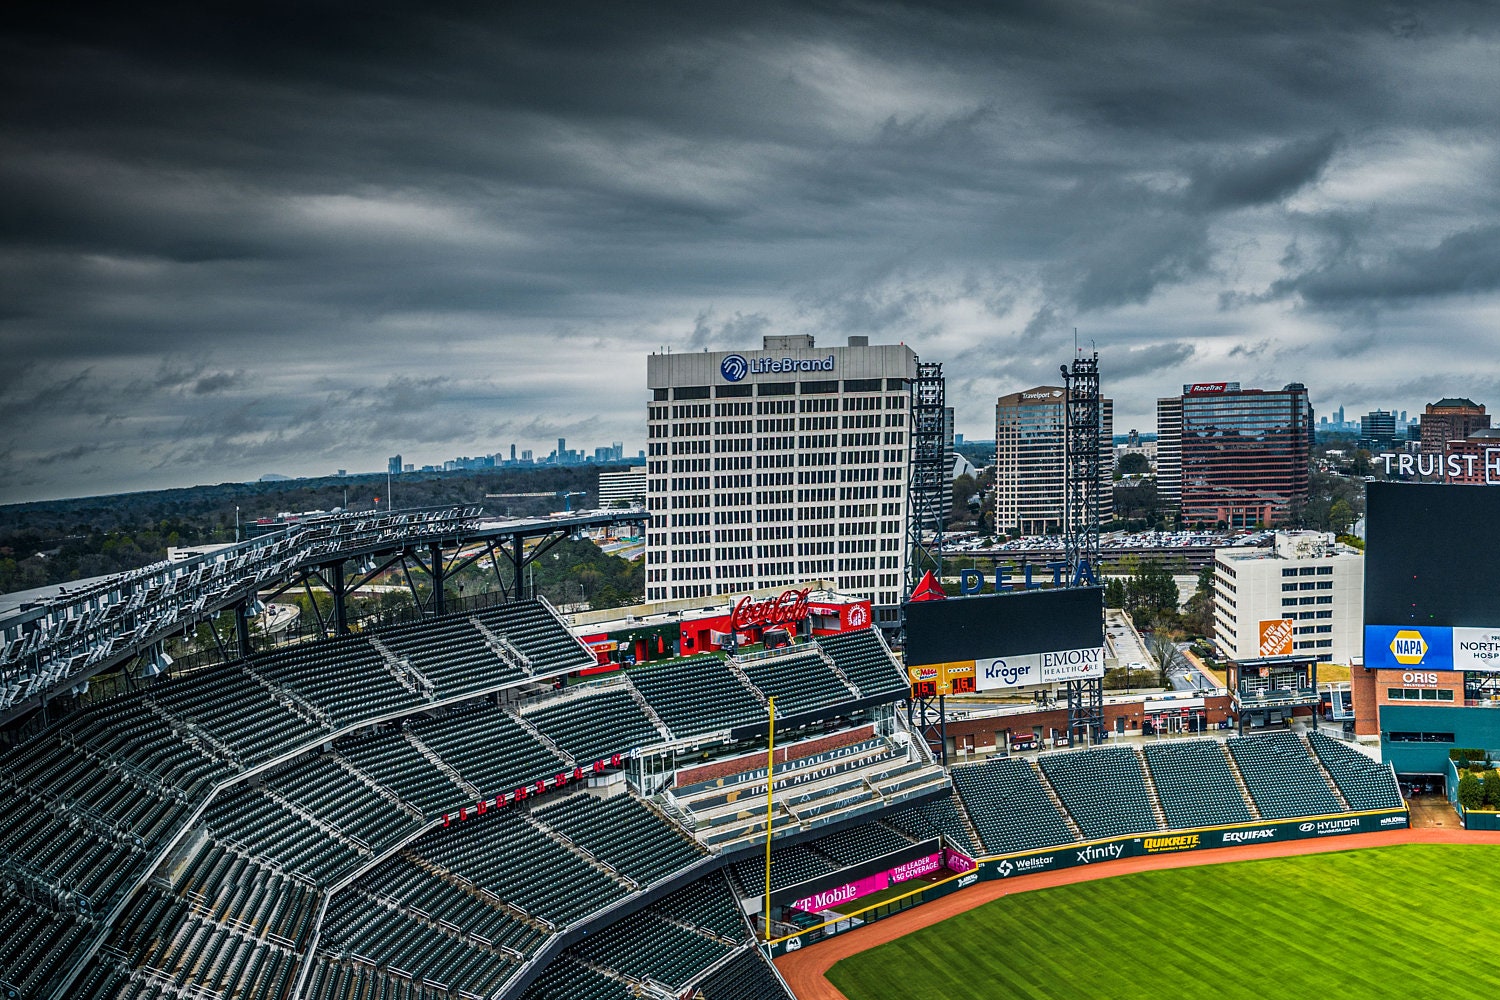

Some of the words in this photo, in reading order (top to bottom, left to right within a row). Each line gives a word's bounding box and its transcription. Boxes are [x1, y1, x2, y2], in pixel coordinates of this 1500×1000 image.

[751, 356, 834, 373] LifeBrand
[1380, 453, 1478, 477] TRUIST
[961, 560, 1096, 594] DELTA
[1260, 620, 1293, 655] HOME
[1263, 624, 1276, 638] THE
[1273, 632, 1292, 655] DEPOT
[1396, 639, 1422, 655] NAPA
[1043, 648, 1100, 667] EMORY
[986, 660, 1031, 685] Kroger
[1044, 664, 1099, 675] HEALTHCARE
[1402, 672, 1438, 684] ORIS
[442, 813, 449, 827] 3
[459, 807, 467, 821] 6
[554, 773, 566, 787] 35
[1317, 819, 1359, 830] HYUNDAI
[1144, 835, 1200, 848] QUIKRETE
[1222, 829, 1274, 843] EQUIFAX
[1016, 856, 1054, 868] Wellstar
[1076, 843, 1124, 863] xfinity
[894, 865, 906, 874] THE
[907, 856, 930, 870] LEADER
[815, 884, 856, 909] Mobile
